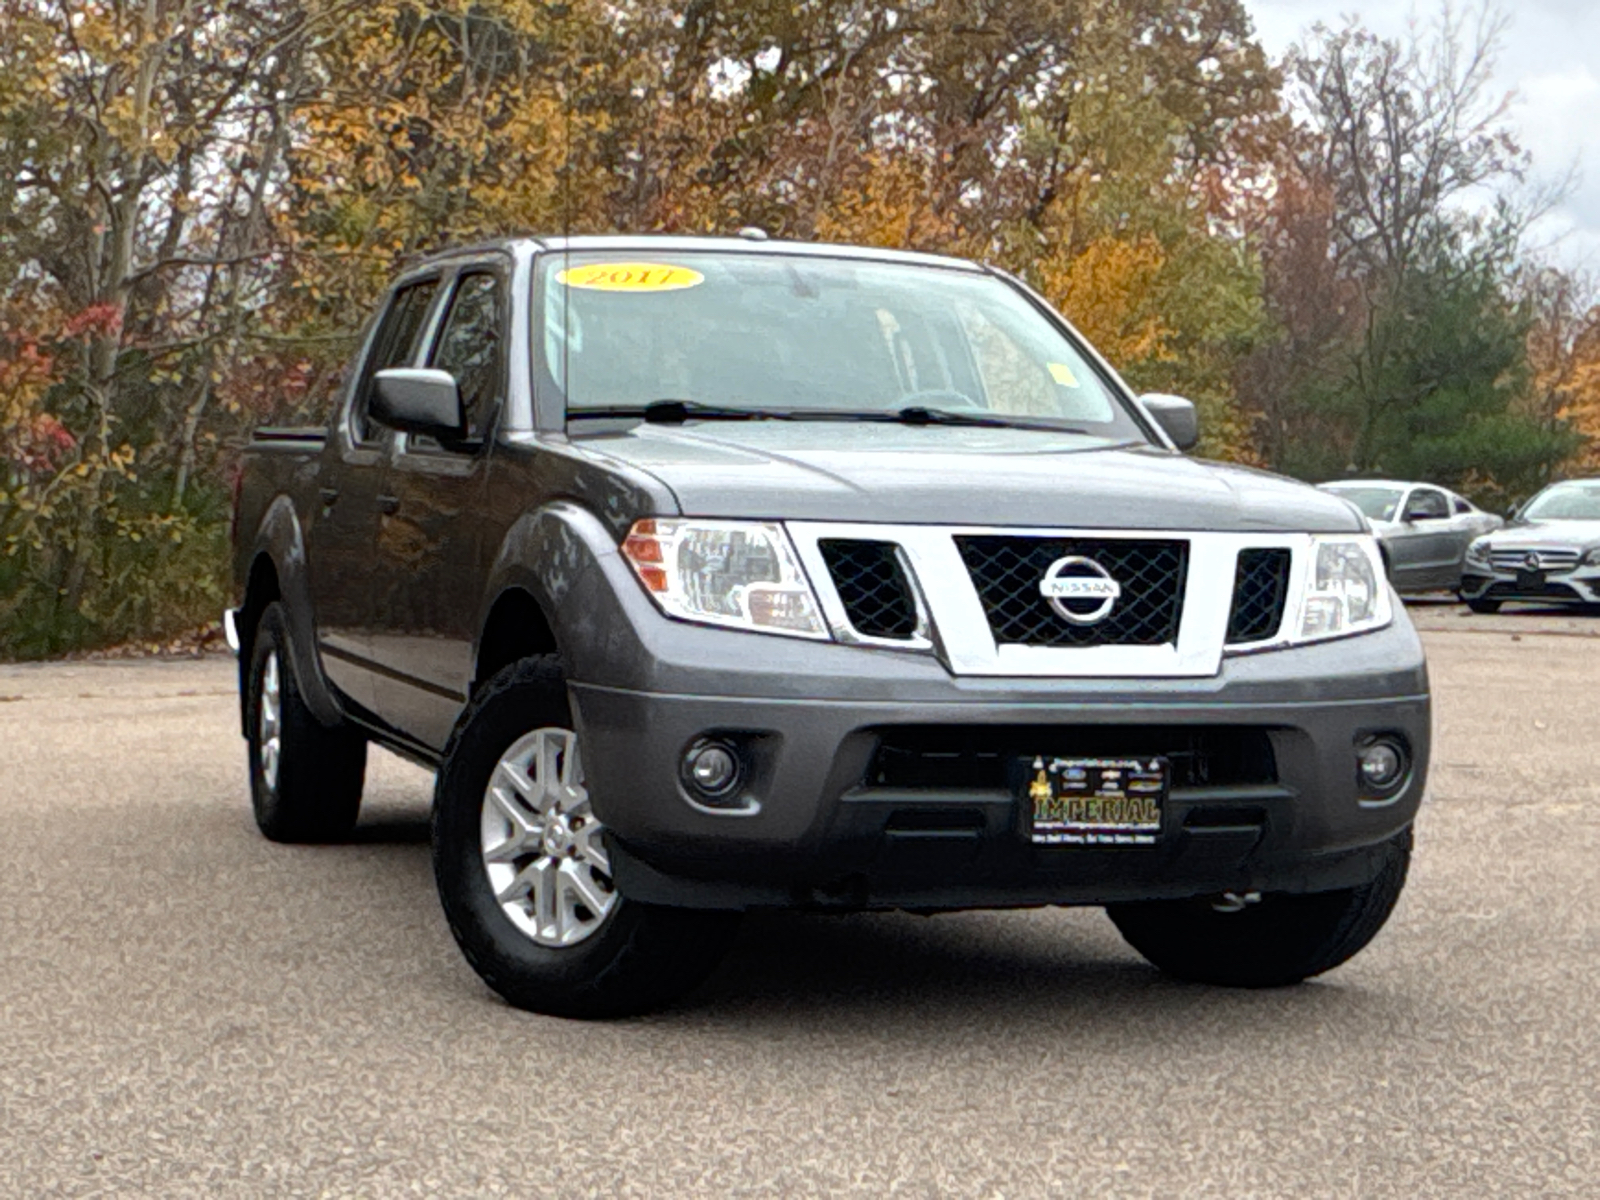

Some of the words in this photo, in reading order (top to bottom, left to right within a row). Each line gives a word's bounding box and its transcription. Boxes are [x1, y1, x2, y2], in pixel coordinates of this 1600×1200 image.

[585, 269, 675, 285] 2017
[1050, 582, 1114, 594] NISSAN
[1033, 797, 1161, 823] IMPERIAL
